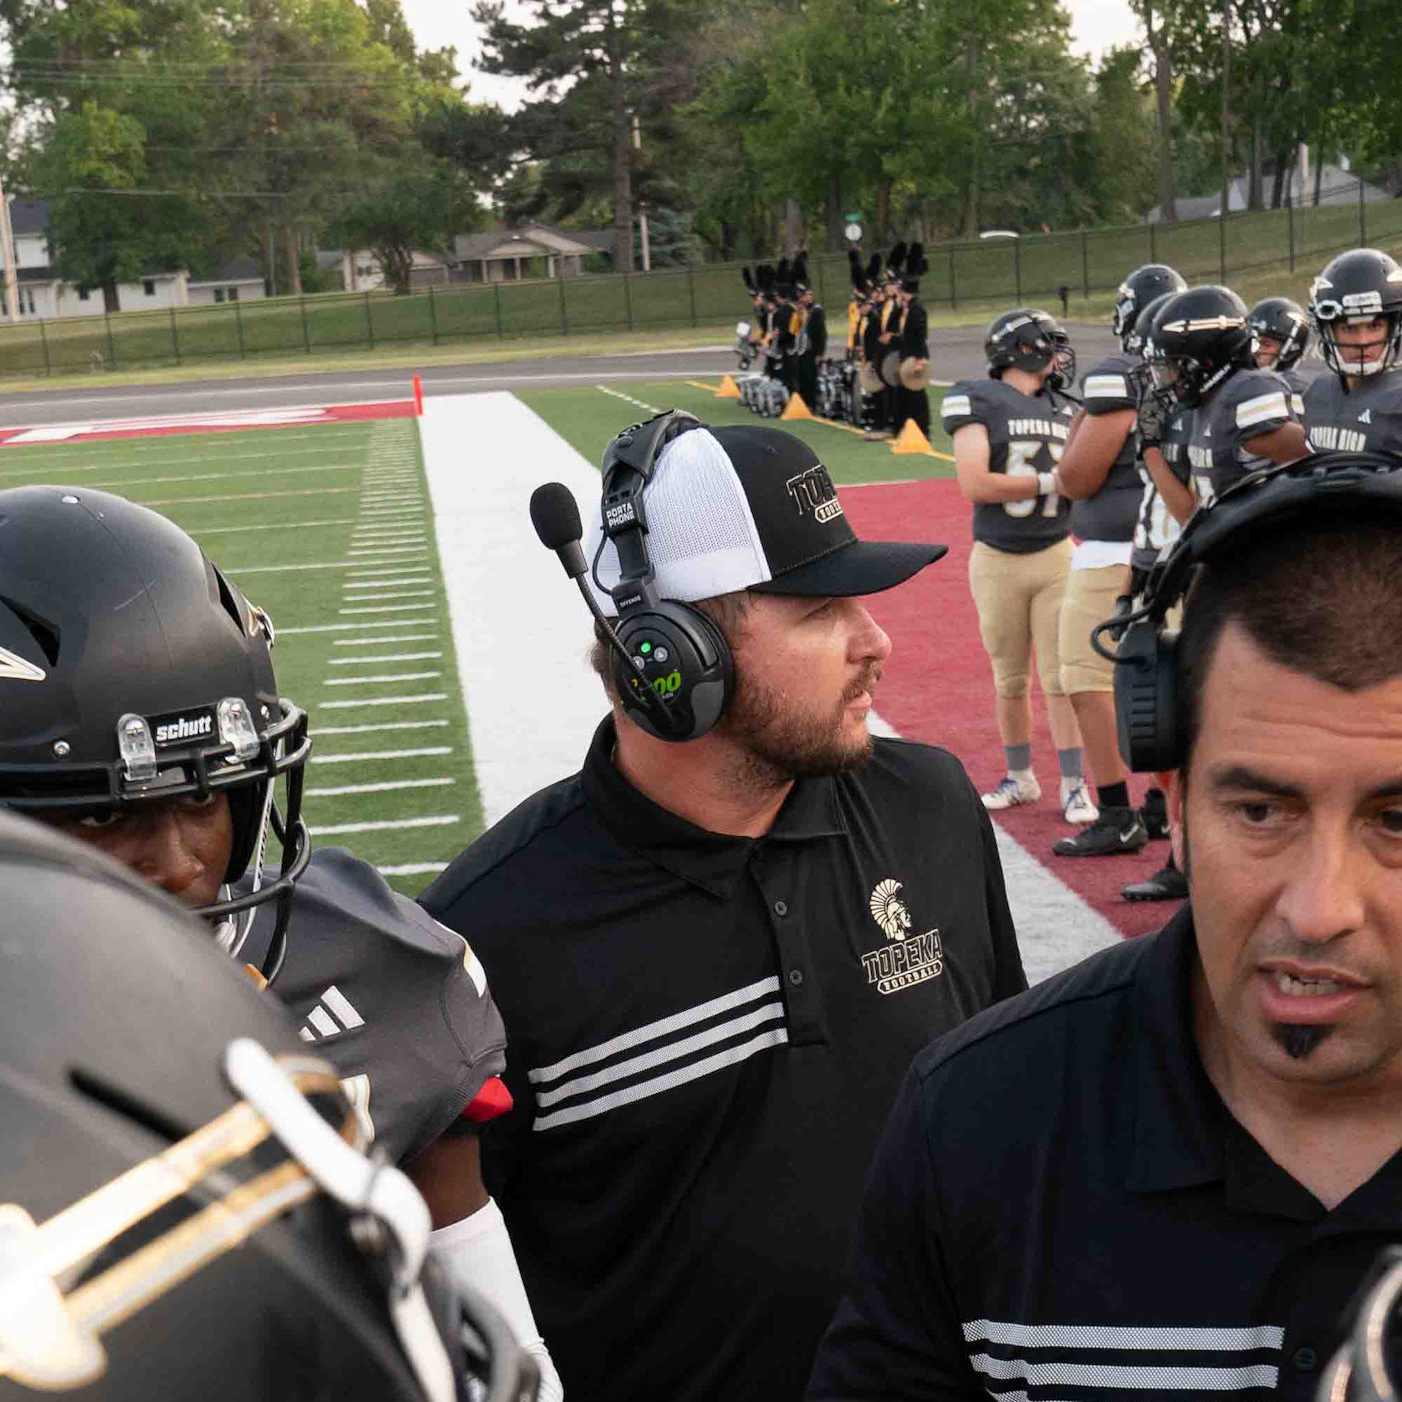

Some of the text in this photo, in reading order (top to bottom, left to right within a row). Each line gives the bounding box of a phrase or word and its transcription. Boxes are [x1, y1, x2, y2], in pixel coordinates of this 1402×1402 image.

[606, 502, 633, 520] PORTA
[608, 511, 635, 528] PHONE
[156, 714, 213, 742] schutt
[861, 928, 943, 984] TOPEKA
[883, 962, 939, 991] FOOTBALL
